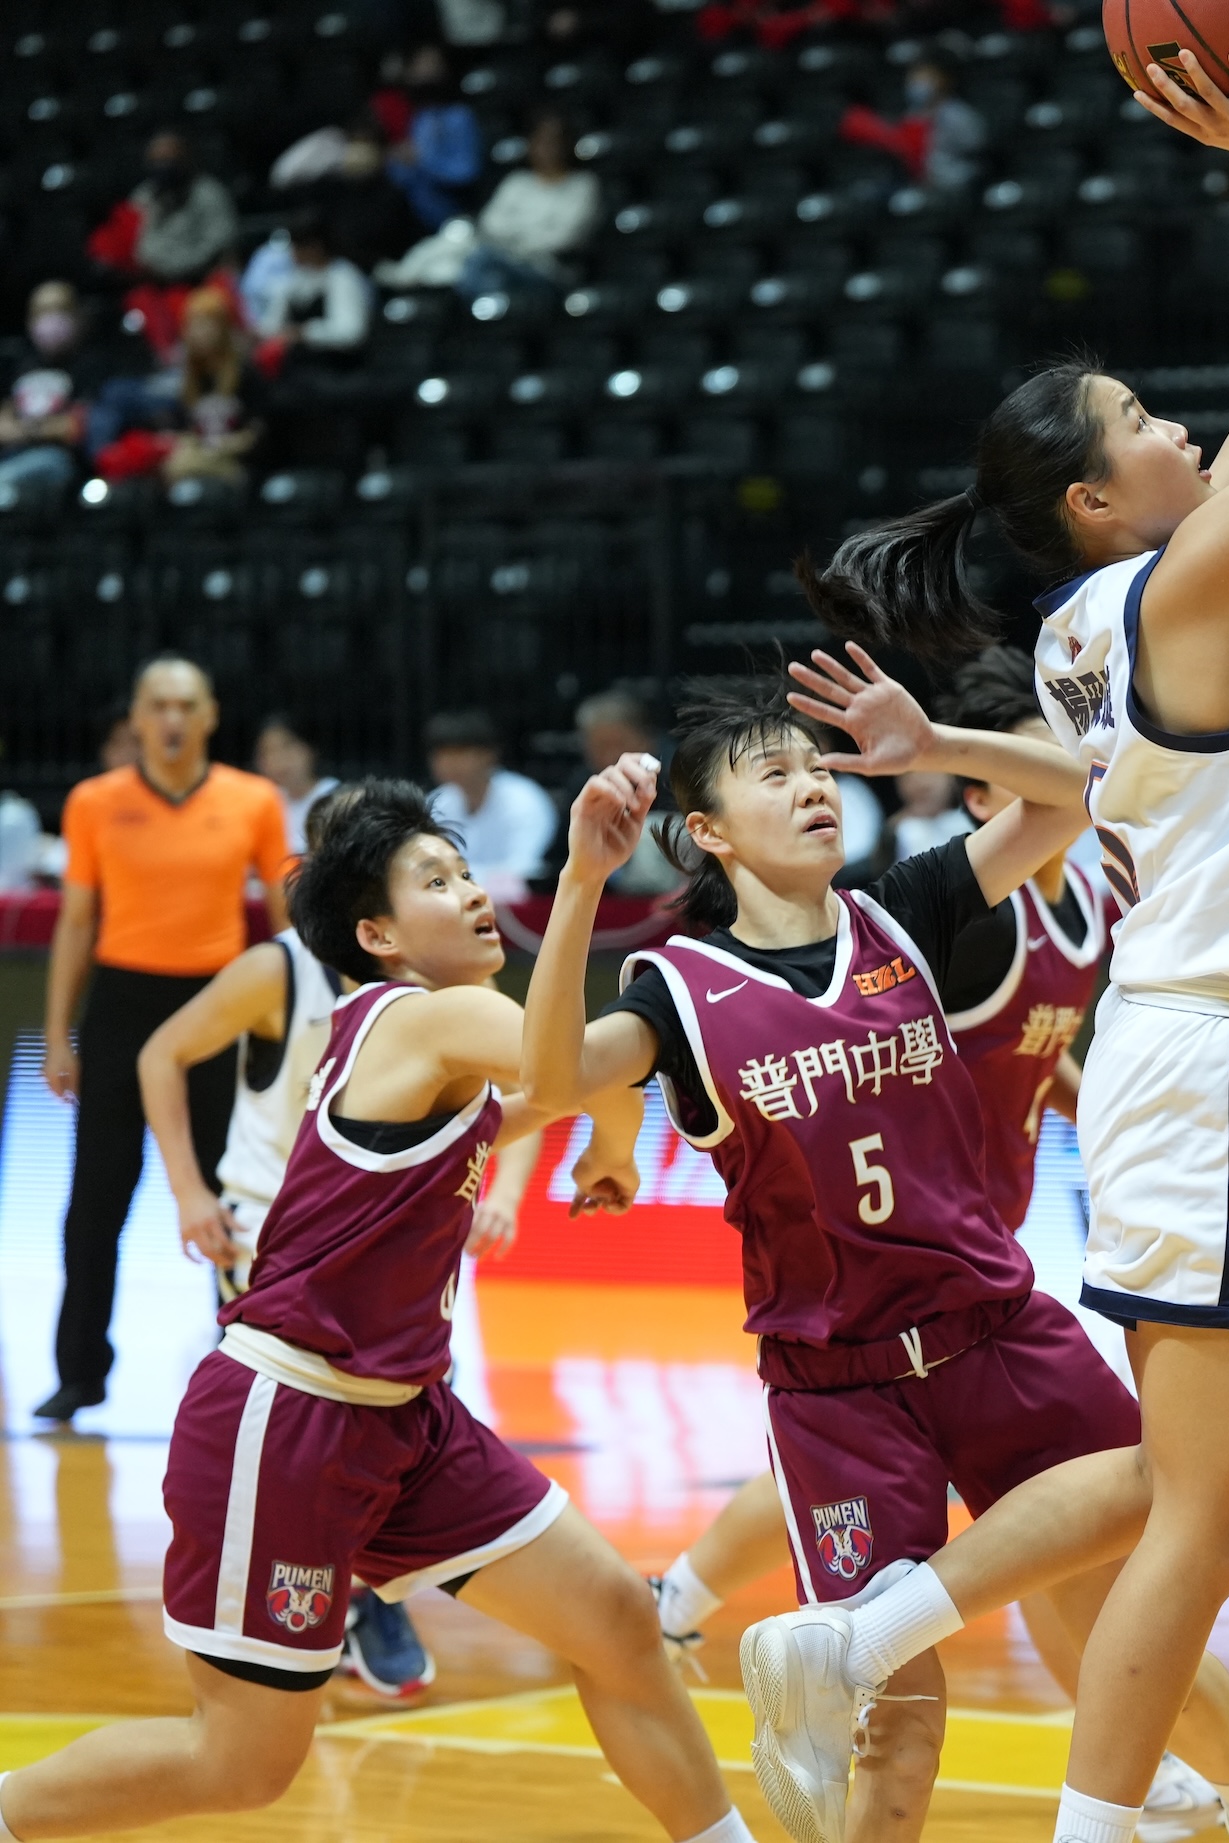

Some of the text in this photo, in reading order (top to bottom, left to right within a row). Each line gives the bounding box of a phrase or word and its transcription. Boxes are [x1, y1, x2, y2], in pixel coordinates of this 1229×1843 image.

[738, 1015, 944, 1121] 普門中學
[848, 1132, 895, 1225] 5
[812, 1499, 868, 1537] PUMEN
[271, 1563, 333, 1593] PUMEN
